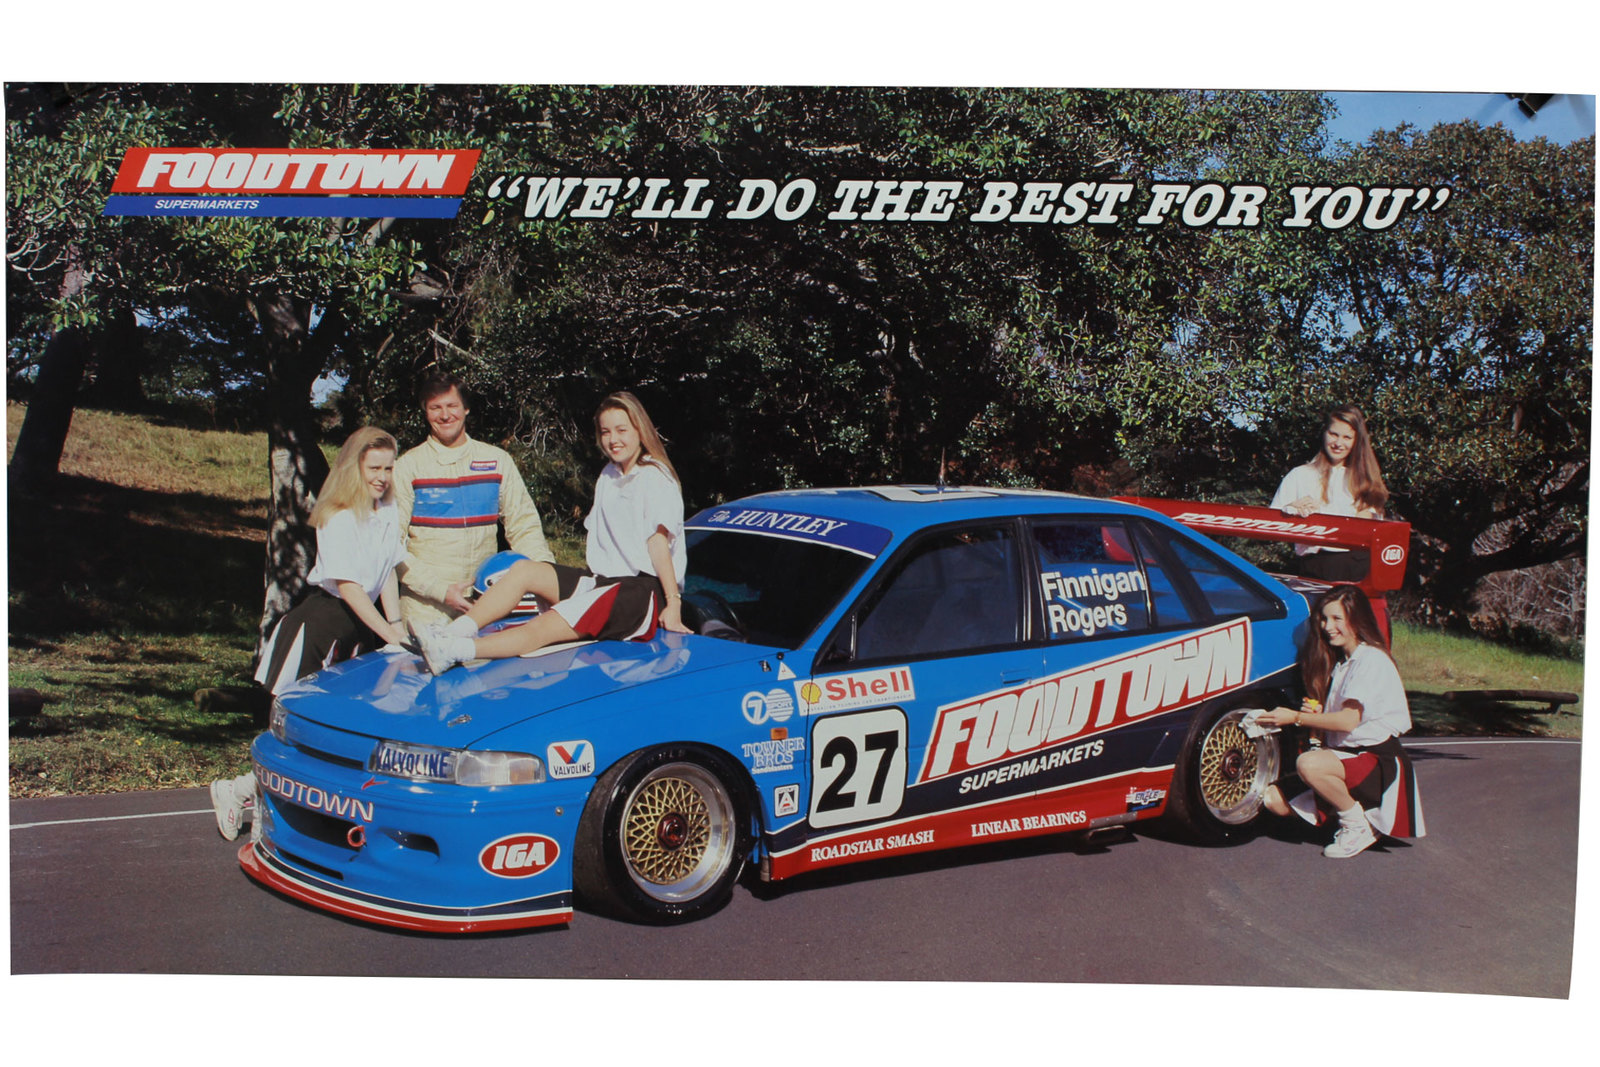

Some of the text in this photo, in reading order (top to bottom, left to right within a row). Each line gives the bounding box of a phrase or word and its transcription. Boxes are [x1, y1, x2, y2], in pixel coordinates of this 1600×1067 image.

[137, 153, 456, 189] FOODTOWN
[155, 199, 260, 210] SUPERMARKETS
[726, 178, 817, 221] DO
[827, 180, 964, 222] THE
[970, 181, 1133, 225] BEST
[1138, 183, 1267, 226] FOR
[726, 510, 848, 537] HUNTLEY
[1172, 512, 1339, 535] FOODTOWN
[1040, 567, 1147, 600] Finnigan
[1048, 601, 1127, 636] Rogers
[825, 670, 910, 701] Shell
[928, 623, 1246, 779] FOODTOWN
[376, 741, 451, 778] VALVOLINE
[741, 737, 805, 757] TOWNER
[753, 750, 794, 769] BROS
[553, 762, 591, 775] VALVOLINE
[815, 730, 899, 813] 27
[958, 739, 1105, 794] SUPERMARKETS
[255, 763, 374, 823] FOODTOWN
[971, 810, 1087, 837] LINEAR BEARINGS
[492, 842, 547, 870] IGA
[811, 830, 935, 861] ROADSTAR SMASH
